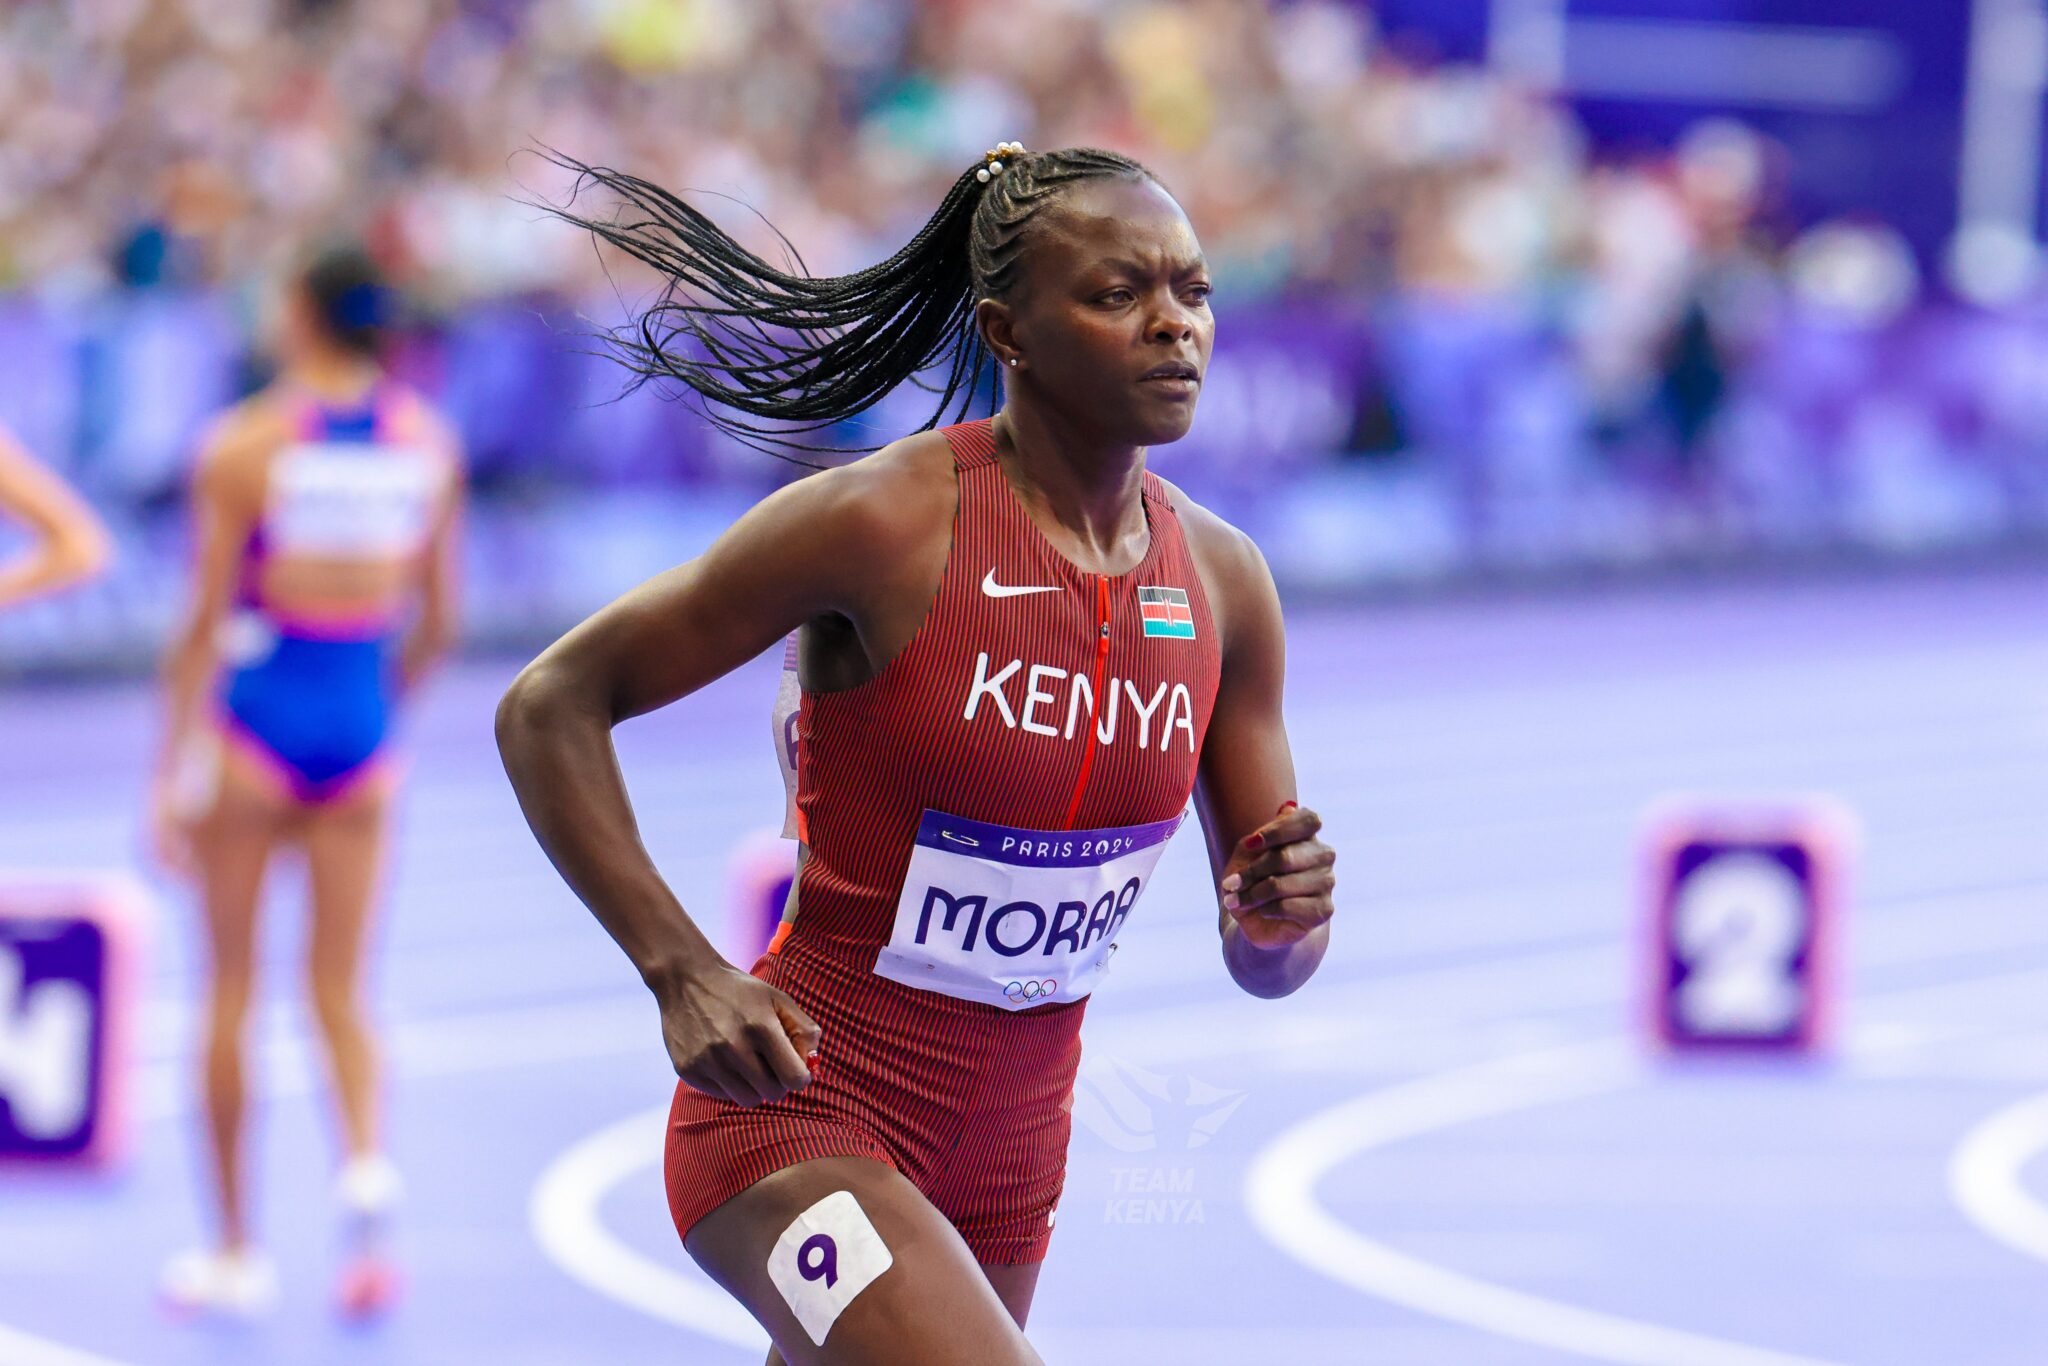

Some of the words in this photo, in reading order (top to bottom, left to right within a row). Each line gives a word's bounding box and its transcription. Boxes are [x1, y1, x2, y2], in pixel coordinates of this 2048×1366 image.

[964, 652, 1195, 753] KENYA
[1002, 836, 1073, 858] PARIS
[1080, 837, 1134, 858] 2024
[914, 876, 1140, 957] MORAA
[1673, 852, 1806, 1035] 2
[797, 1233, 839, 1290] 9
